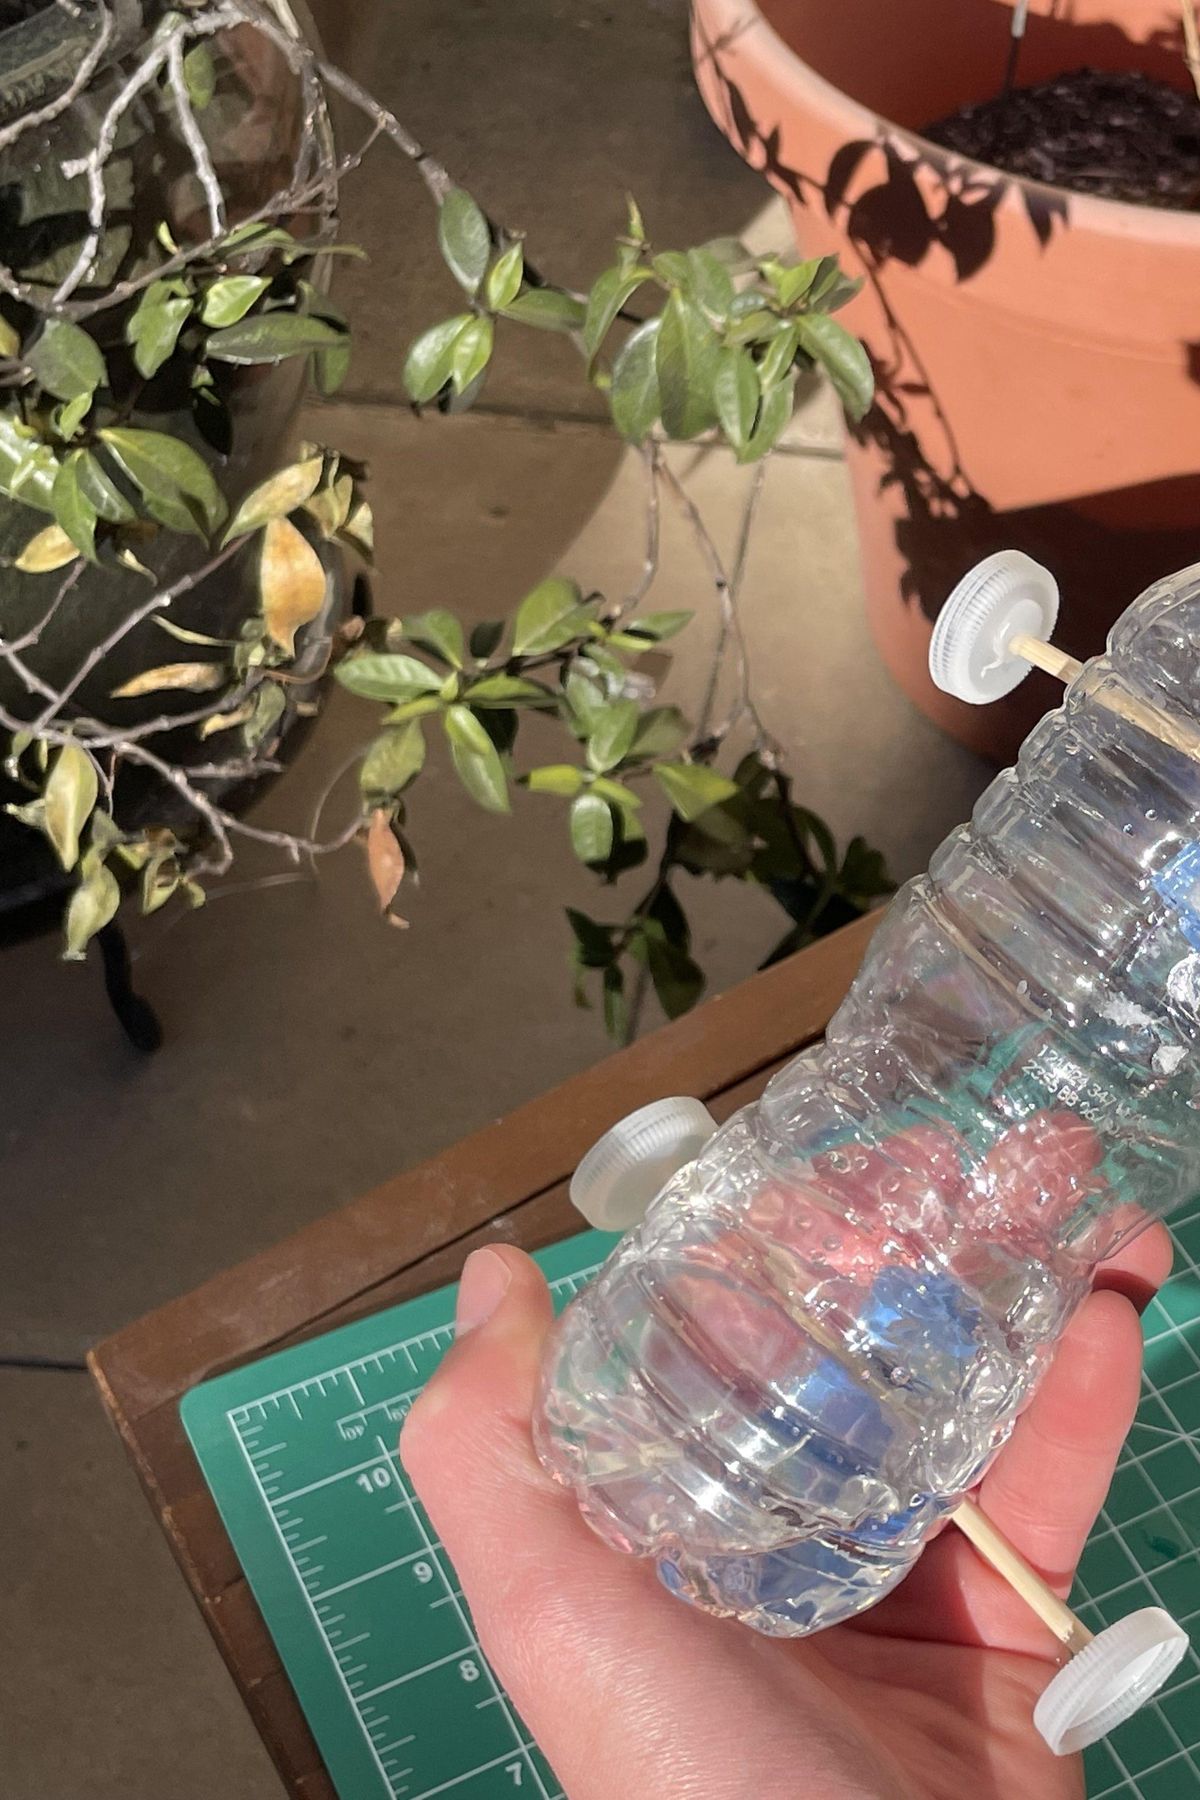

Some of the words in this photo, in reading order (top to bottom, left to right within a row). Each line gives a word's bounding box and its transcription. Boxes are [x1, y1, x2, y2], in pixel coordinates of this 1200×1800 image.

[356, 1464, 392, 1494] 10
[411, 1560, 434, 1584] 9
[459, 1659, 480, 1683] 8
[505, 1761, 525, 1787] 7
